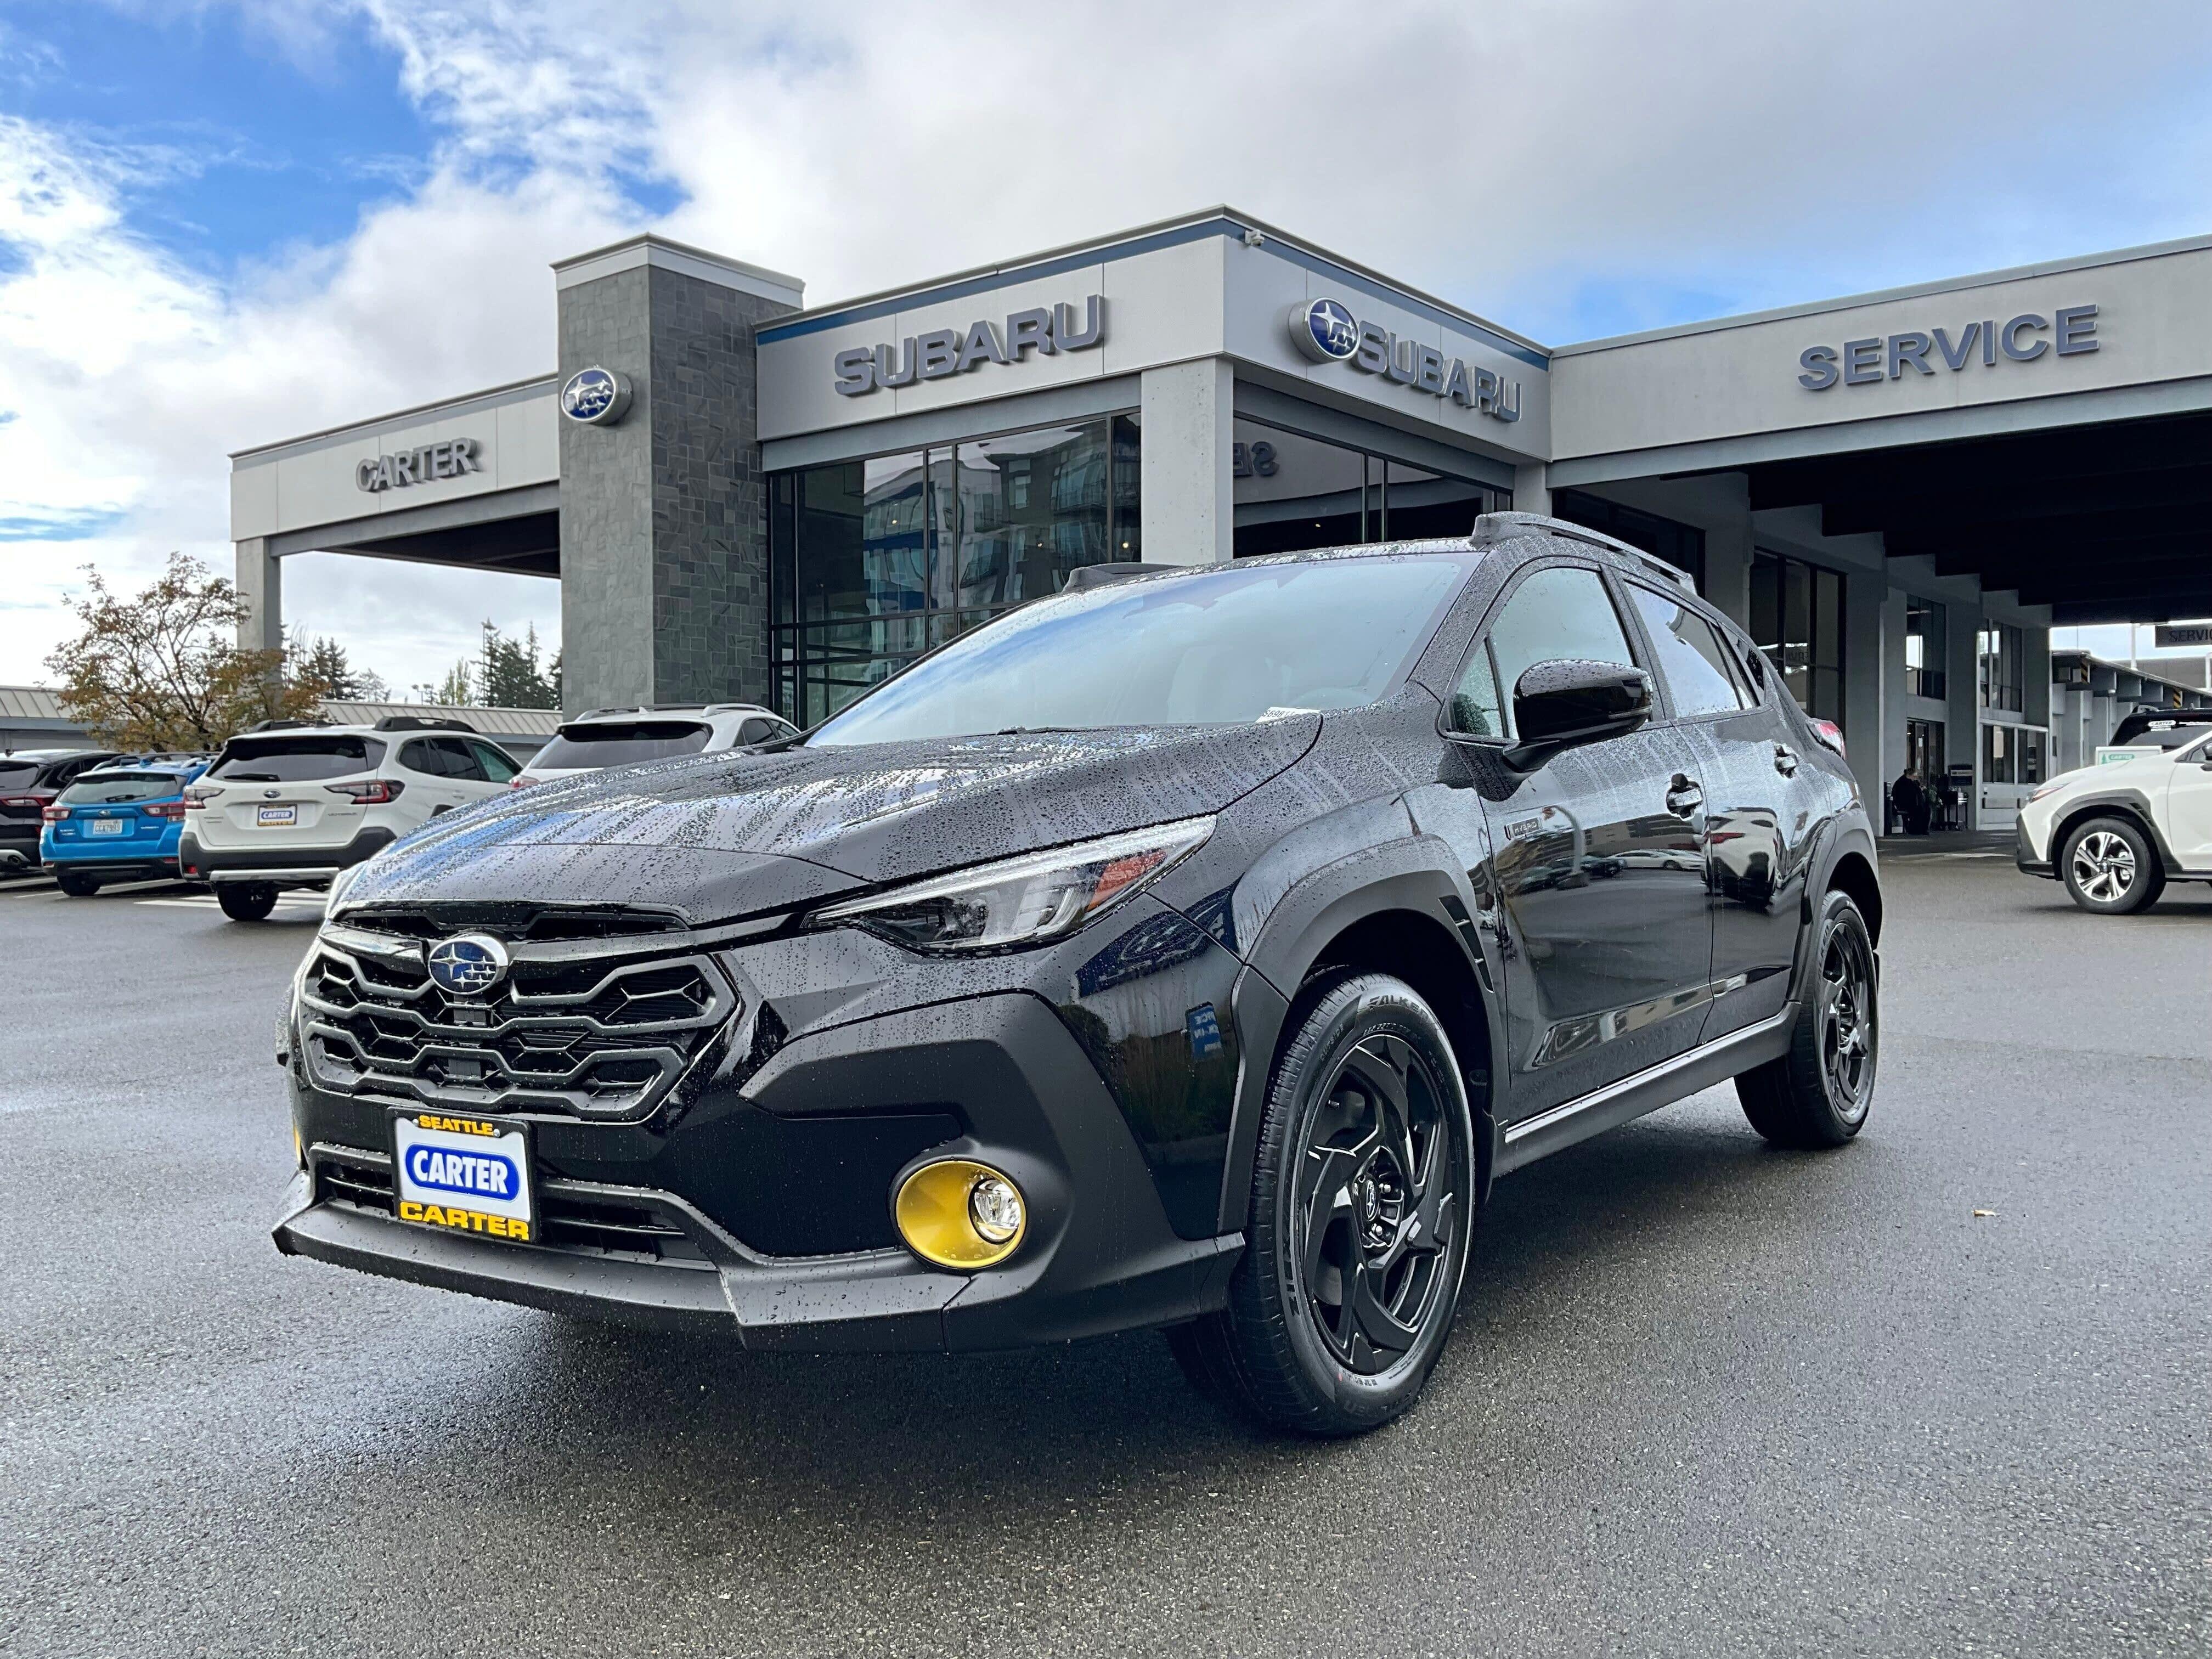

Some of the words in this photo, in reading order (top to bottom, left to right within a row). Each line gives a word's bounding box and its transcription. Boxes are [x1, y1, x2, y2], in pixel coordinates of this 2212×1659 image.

[834, 294, 1104, 397] SUBARU
[1797, 303, 2100, 390] SERVICE
[1356, 319, 1521, 422] SUBARU
[356, 437, 478, 492] CARTER
[1515, 821, 1537, 833] HYBRID
[1366, 994, 1429, 1022] FALKEN
[419, 1114, 494, 1136] SEATTLE
[413, 1149, 509, 1194] CARTER
[399, 1201, 529, 1240] CARTER
